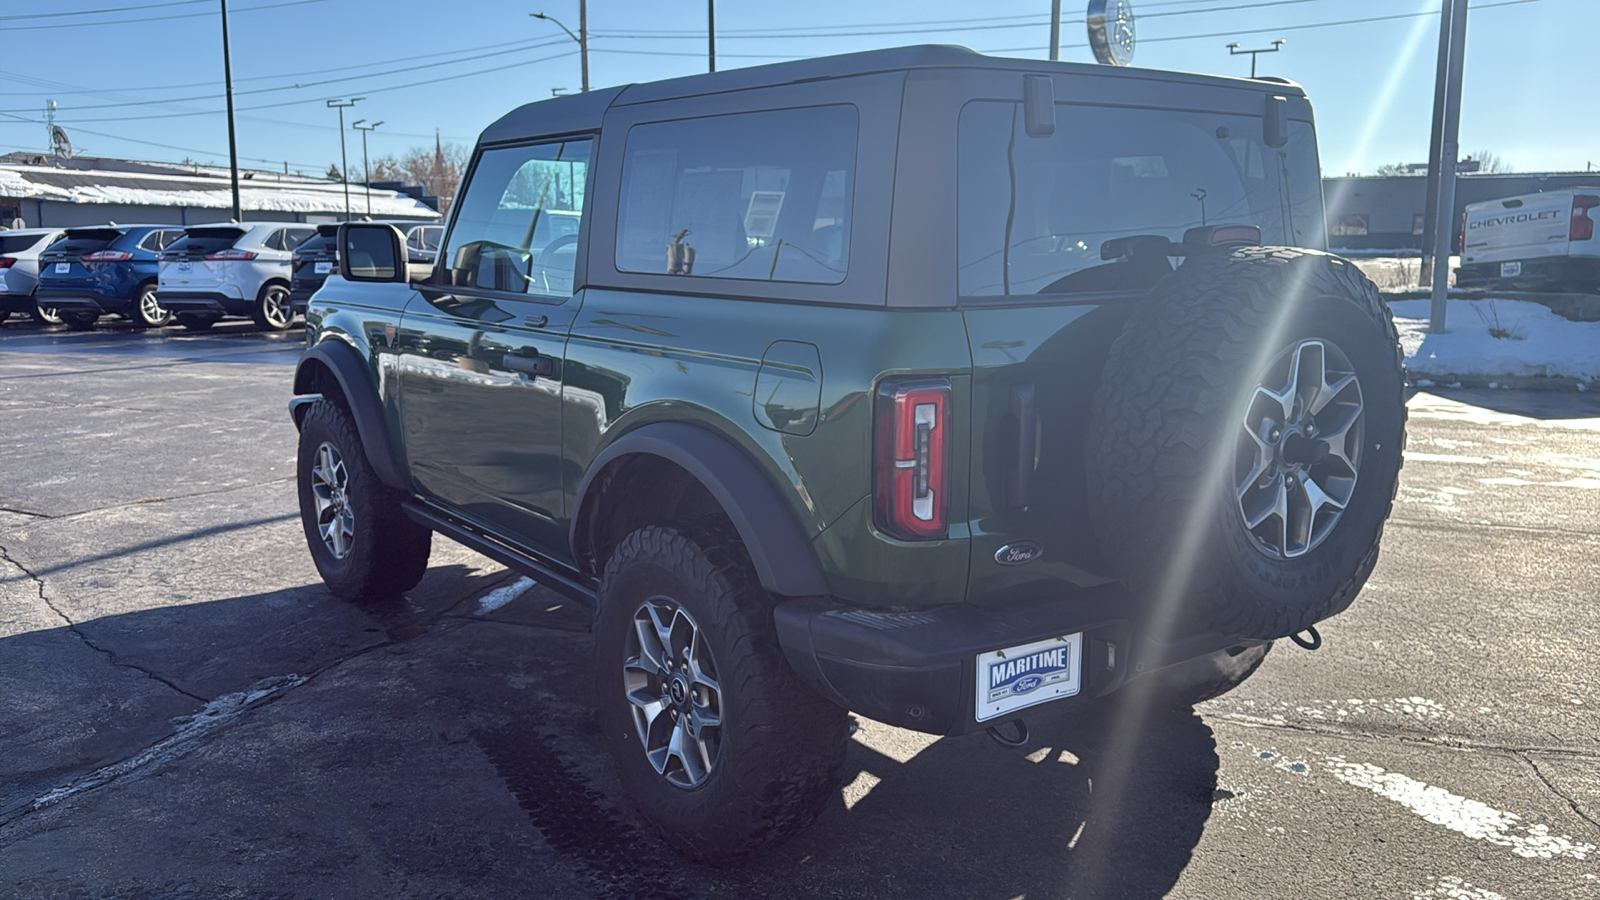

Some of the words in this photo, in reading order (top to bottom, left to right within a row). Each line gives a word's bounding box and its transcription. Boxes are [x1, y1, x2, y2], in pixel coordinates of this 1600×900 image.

[1469, 210, 1561, 230] CHEVROLET
[1007, 547, 1033, 562] Ford
[992, 648, 1067, 688] MARITIME
[1016, 678, 1038, 692] Ford
